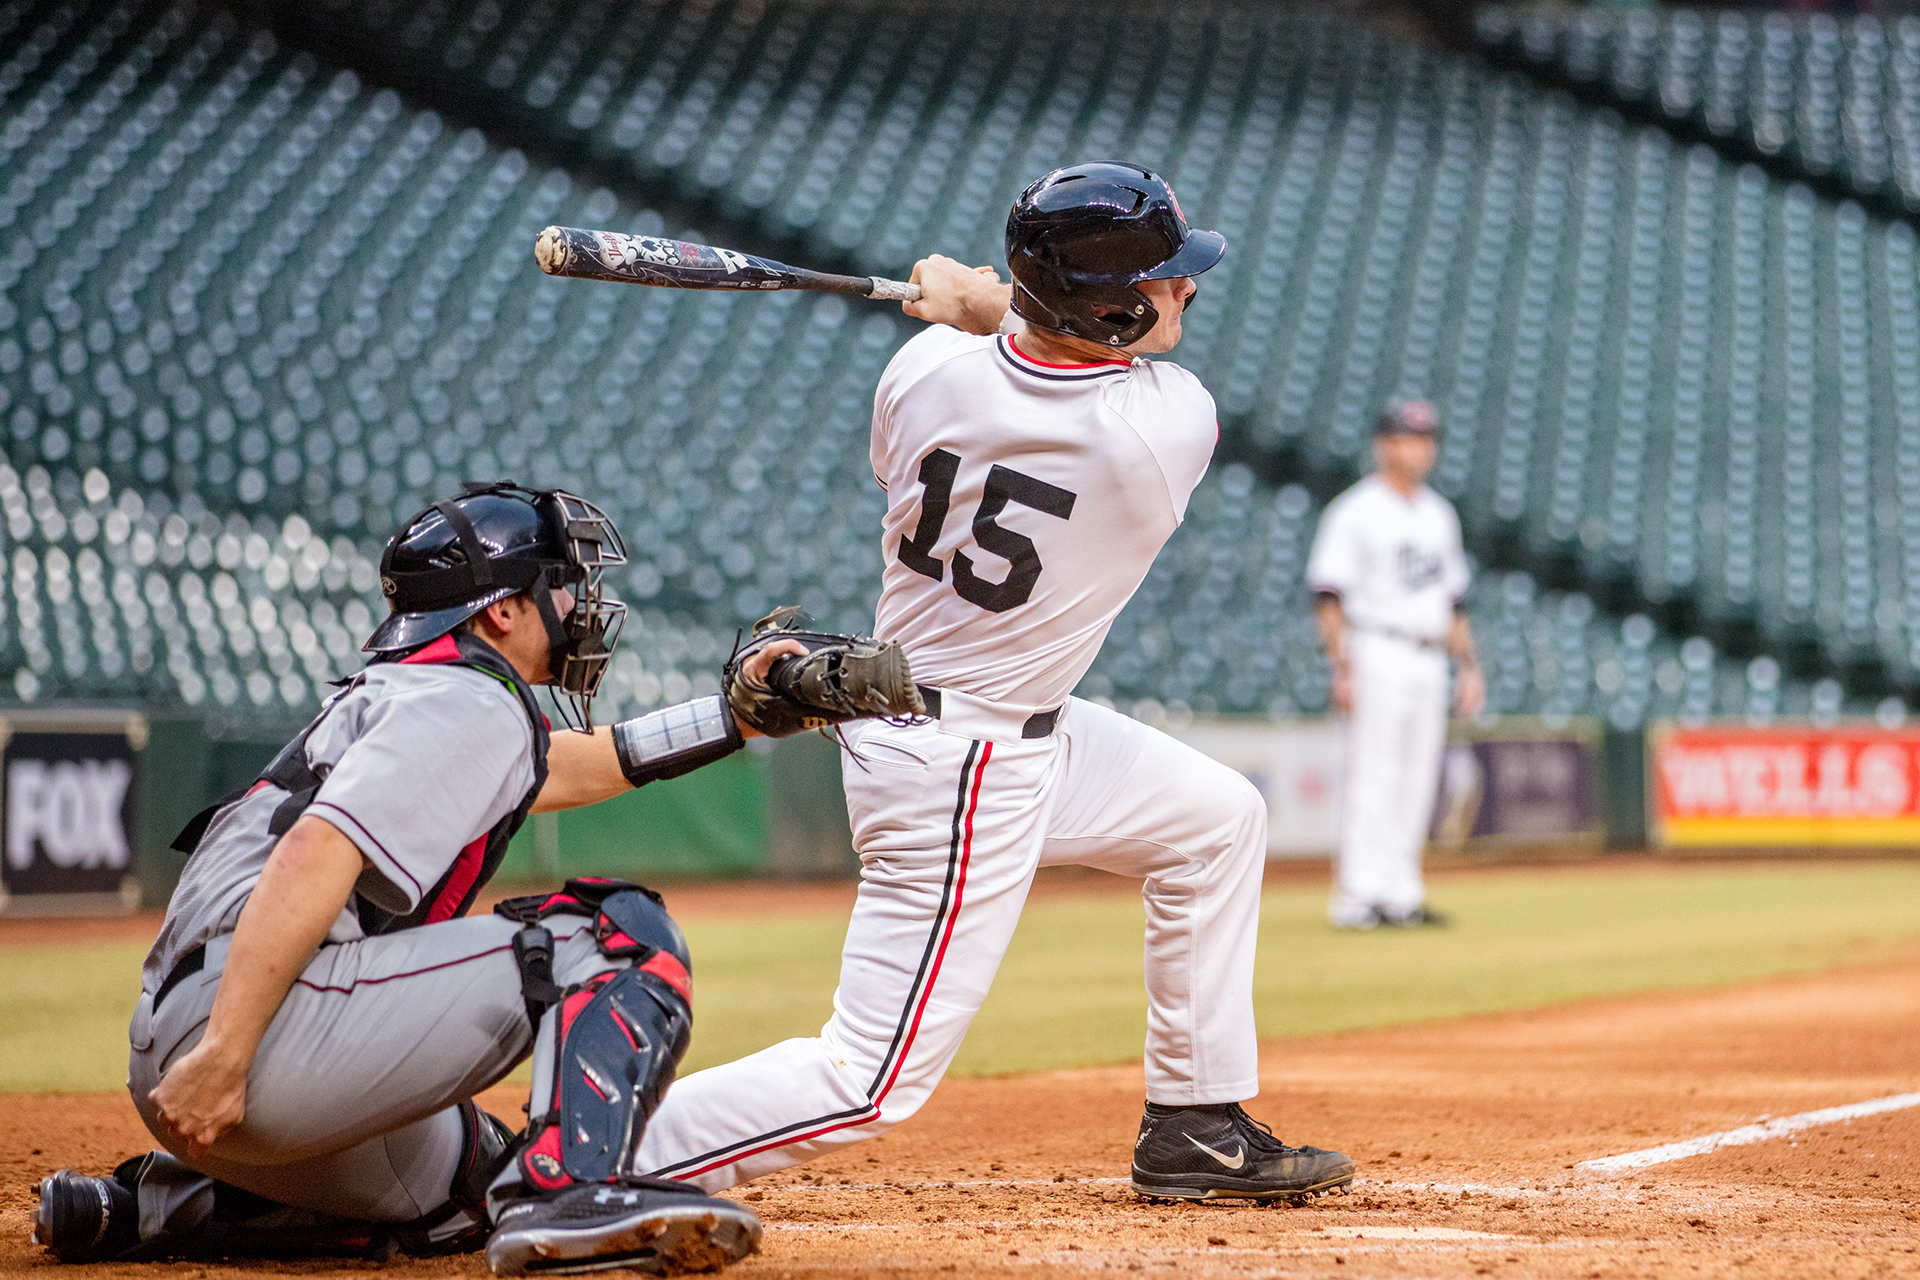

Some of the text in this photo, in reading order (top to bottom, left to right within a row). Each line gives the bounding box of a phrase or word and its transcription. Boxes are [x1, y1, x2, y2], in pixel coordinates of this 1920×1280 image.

[898, 447, 1078, 614] 15
[7, 758, 133, 870] FOX
[1660, 745, 1911, 818] WELLS
